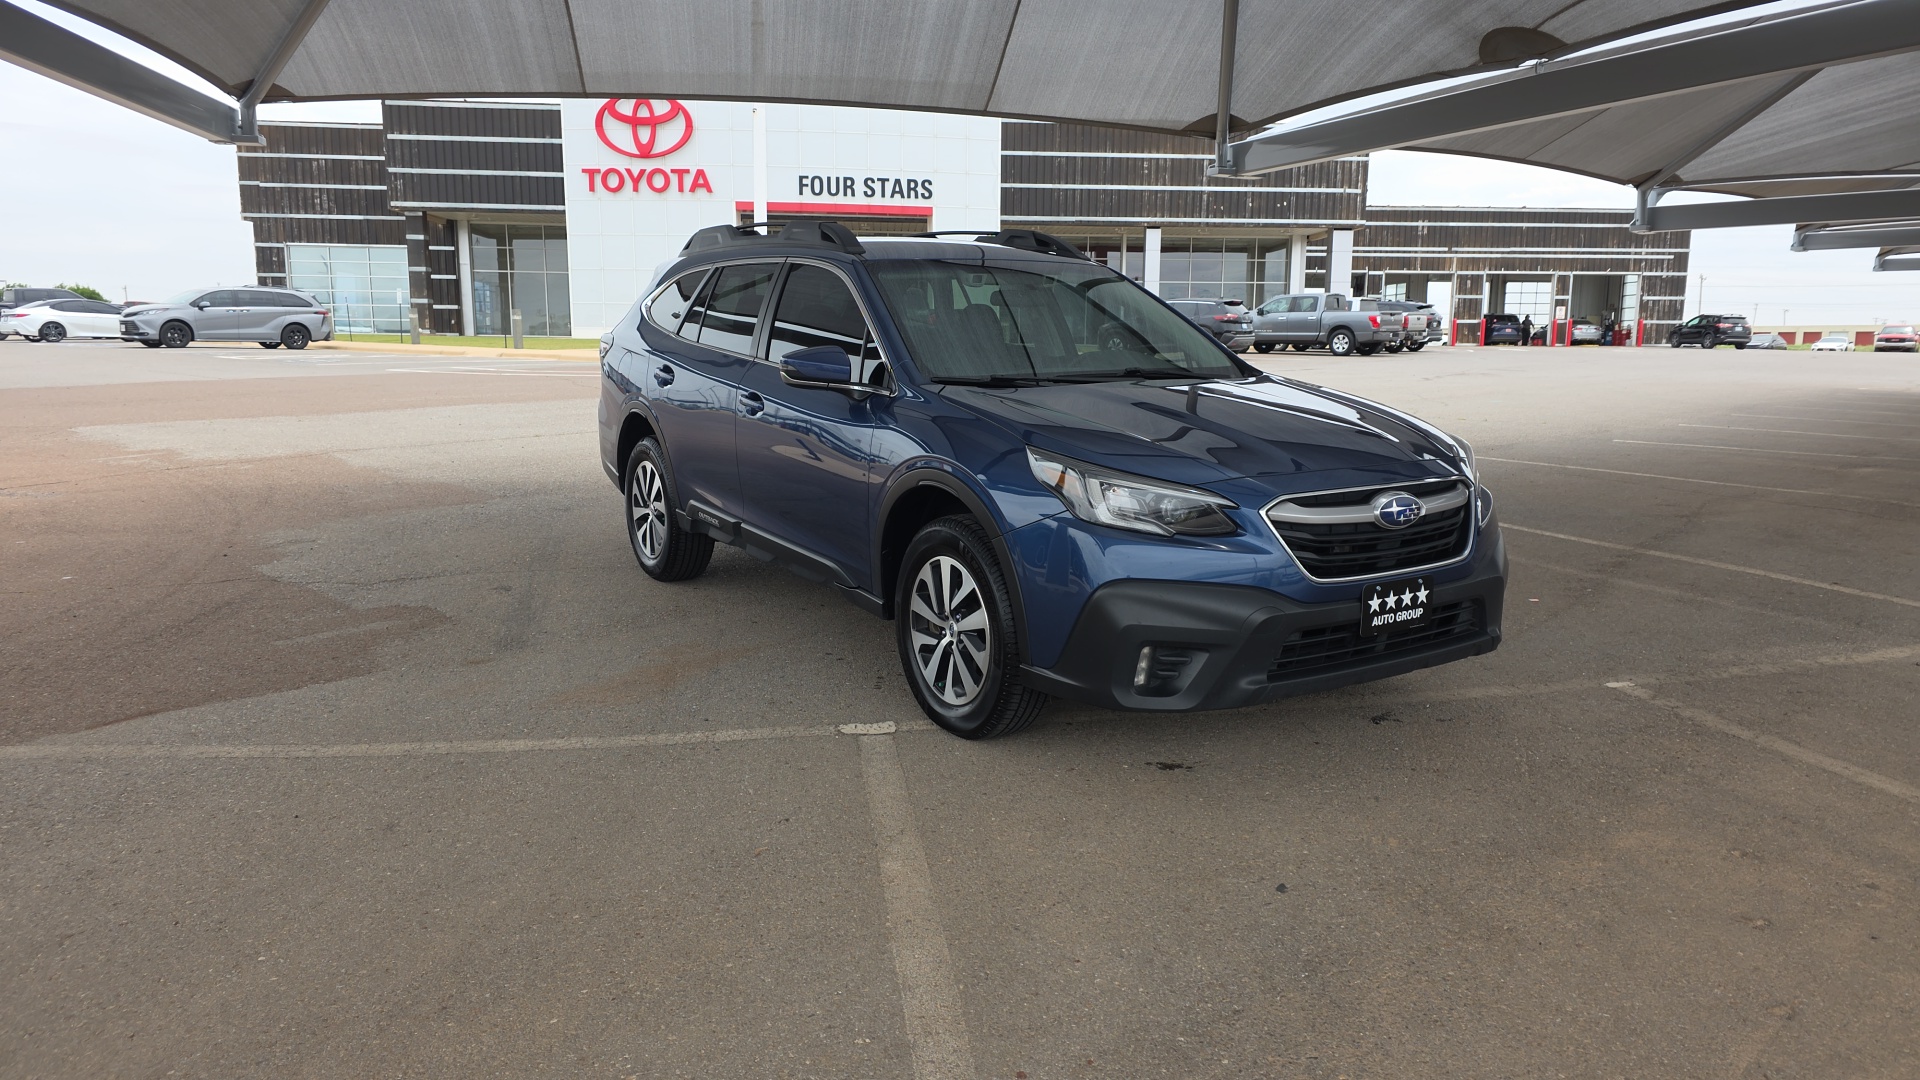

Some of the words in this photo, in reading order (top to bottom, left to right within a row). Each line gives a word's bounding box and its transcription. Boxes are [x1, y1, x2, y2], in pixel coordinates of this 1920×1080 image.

[581, 167, 713, 193] TOYOTA
[798, 175, 856, 197] FOUR
[863, 177, 933, 200] STARS
[1371, 613, 1395, 627] AUTO
[1396, 607, 1424, 622] GROUP
